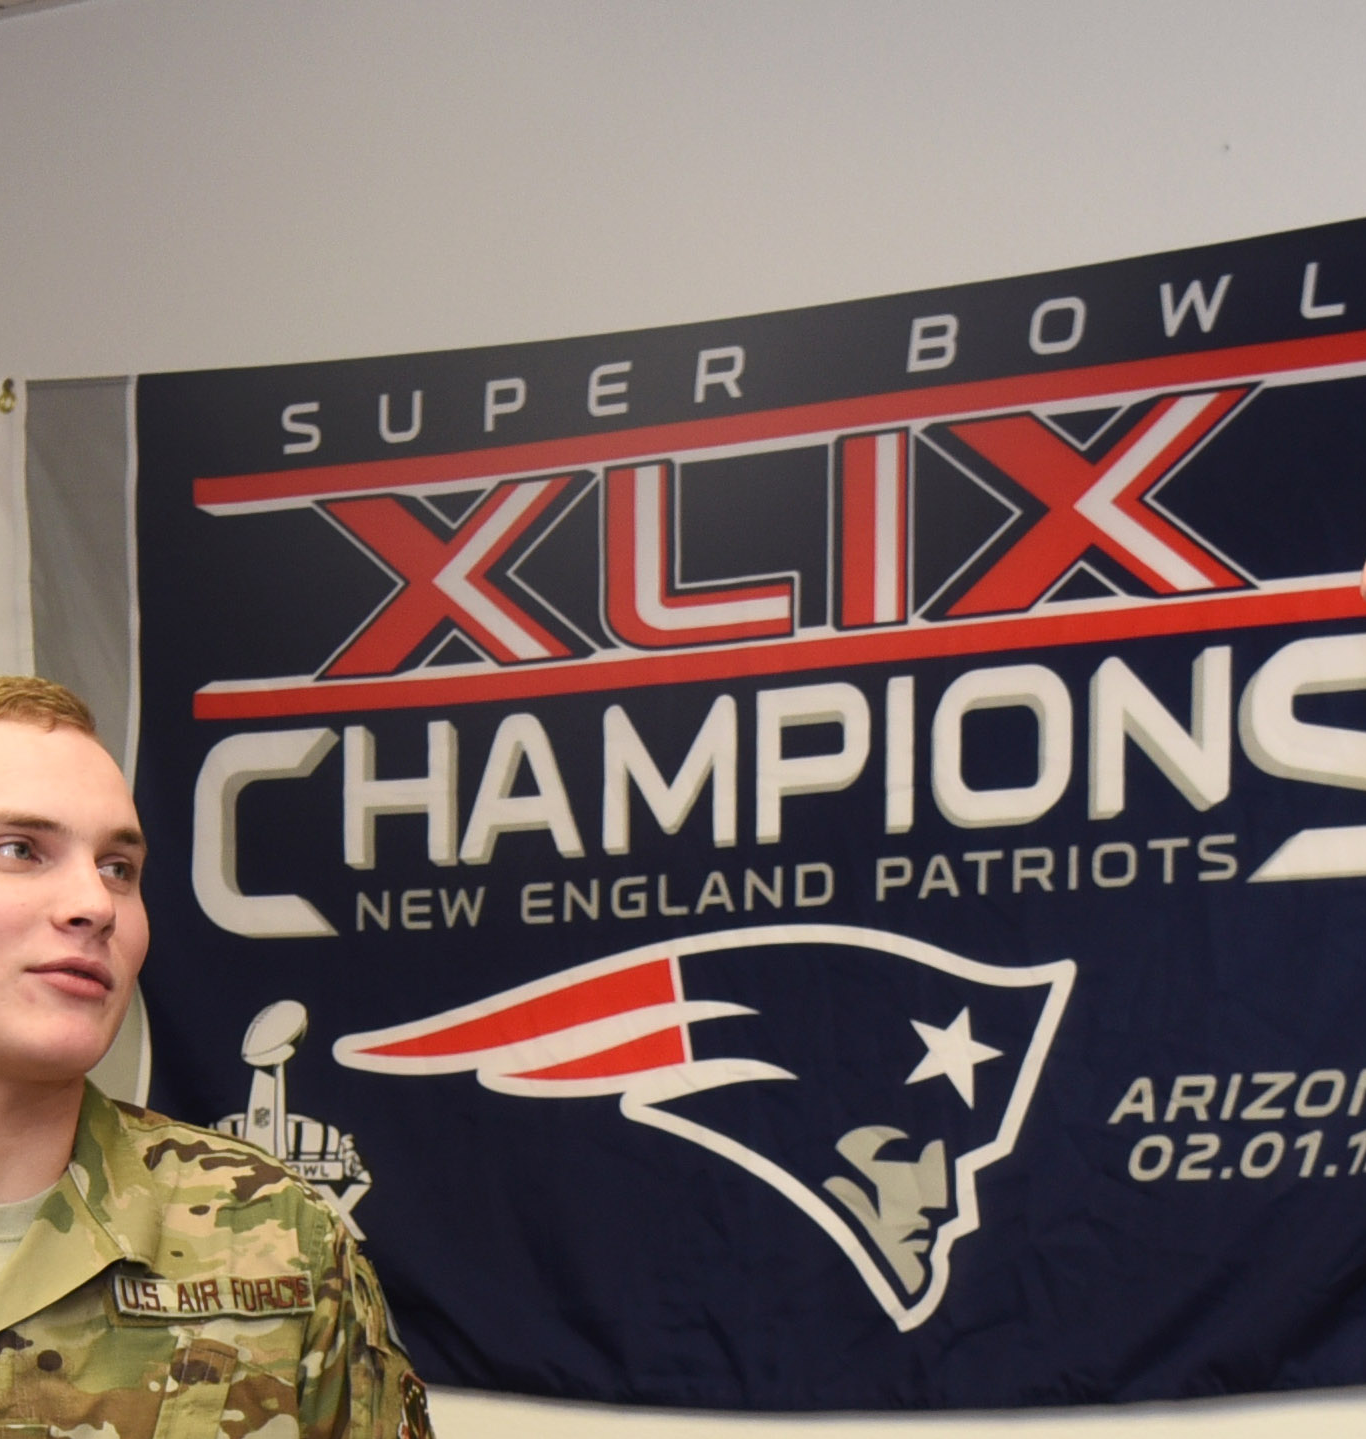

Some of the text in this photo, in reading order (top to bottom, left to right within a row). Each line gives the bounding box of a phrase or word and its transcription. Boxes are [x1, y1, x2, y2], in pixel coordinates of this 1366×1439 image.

[280, 261, 1346, 455] SUPER BOWL
[319, 385, 1257, 679] XLIX
[355, 833, 1238, 932] NEW ENGLAND PATRIOTS
[120, 1276, 311, 1313] U.S. AIR FORCE
